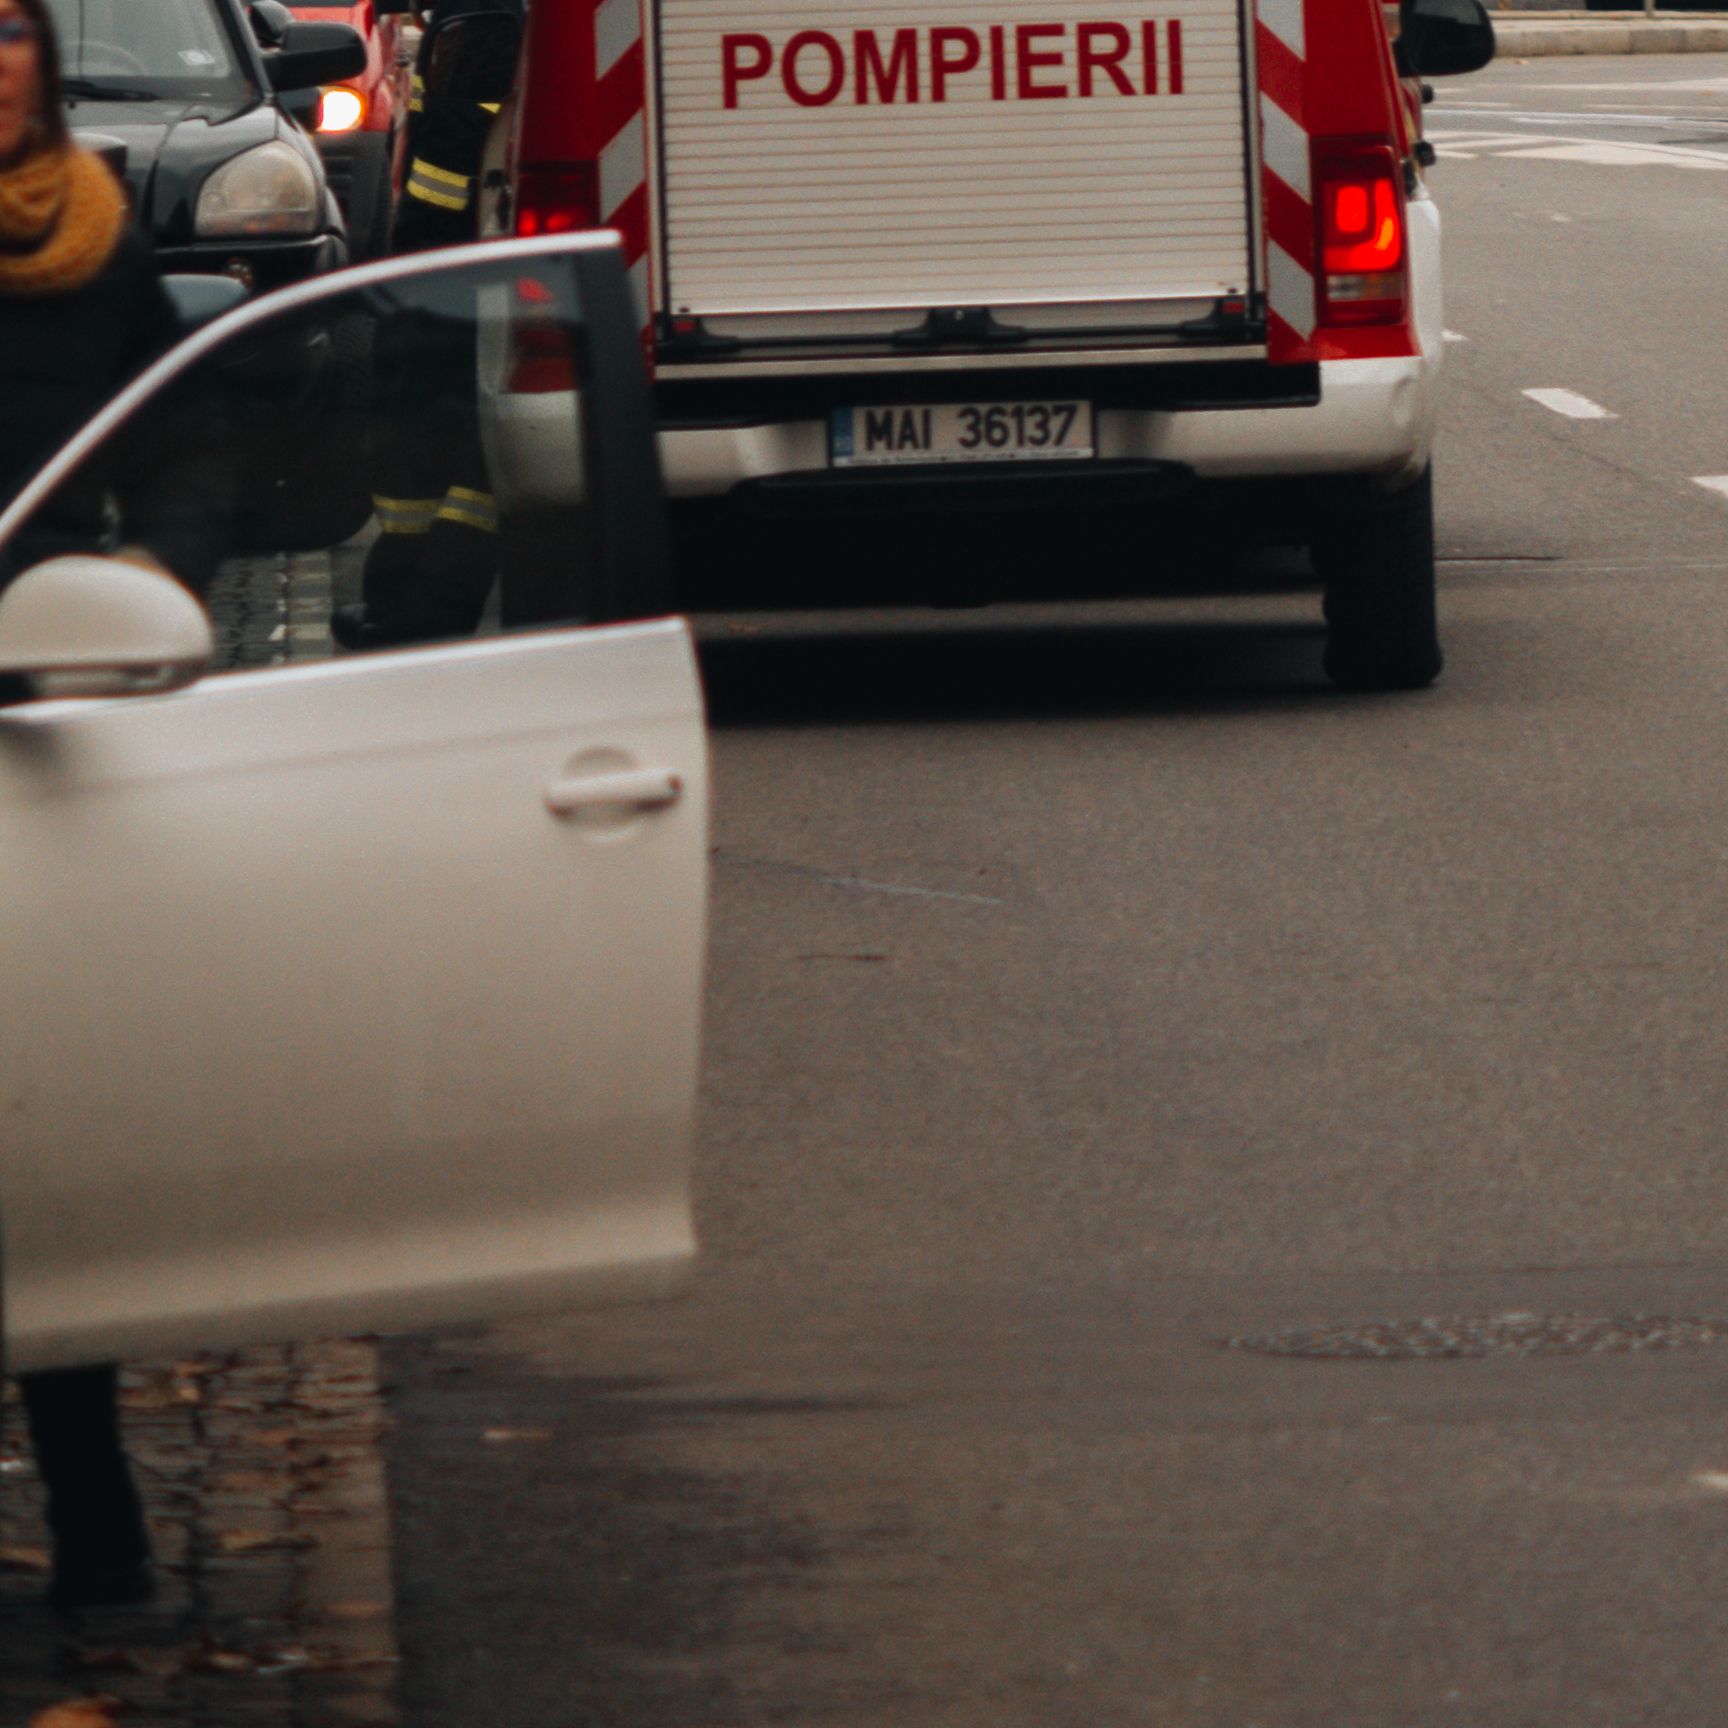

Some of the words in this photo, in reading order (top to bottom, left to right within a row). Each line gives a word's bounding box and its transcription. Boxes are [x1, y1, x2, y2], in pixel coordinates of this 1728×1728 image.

[721, 18, 1185, 110] POMPIERII
[865, 408, 931, 451] MAI
[957, 404, 1079, 448] 36137
